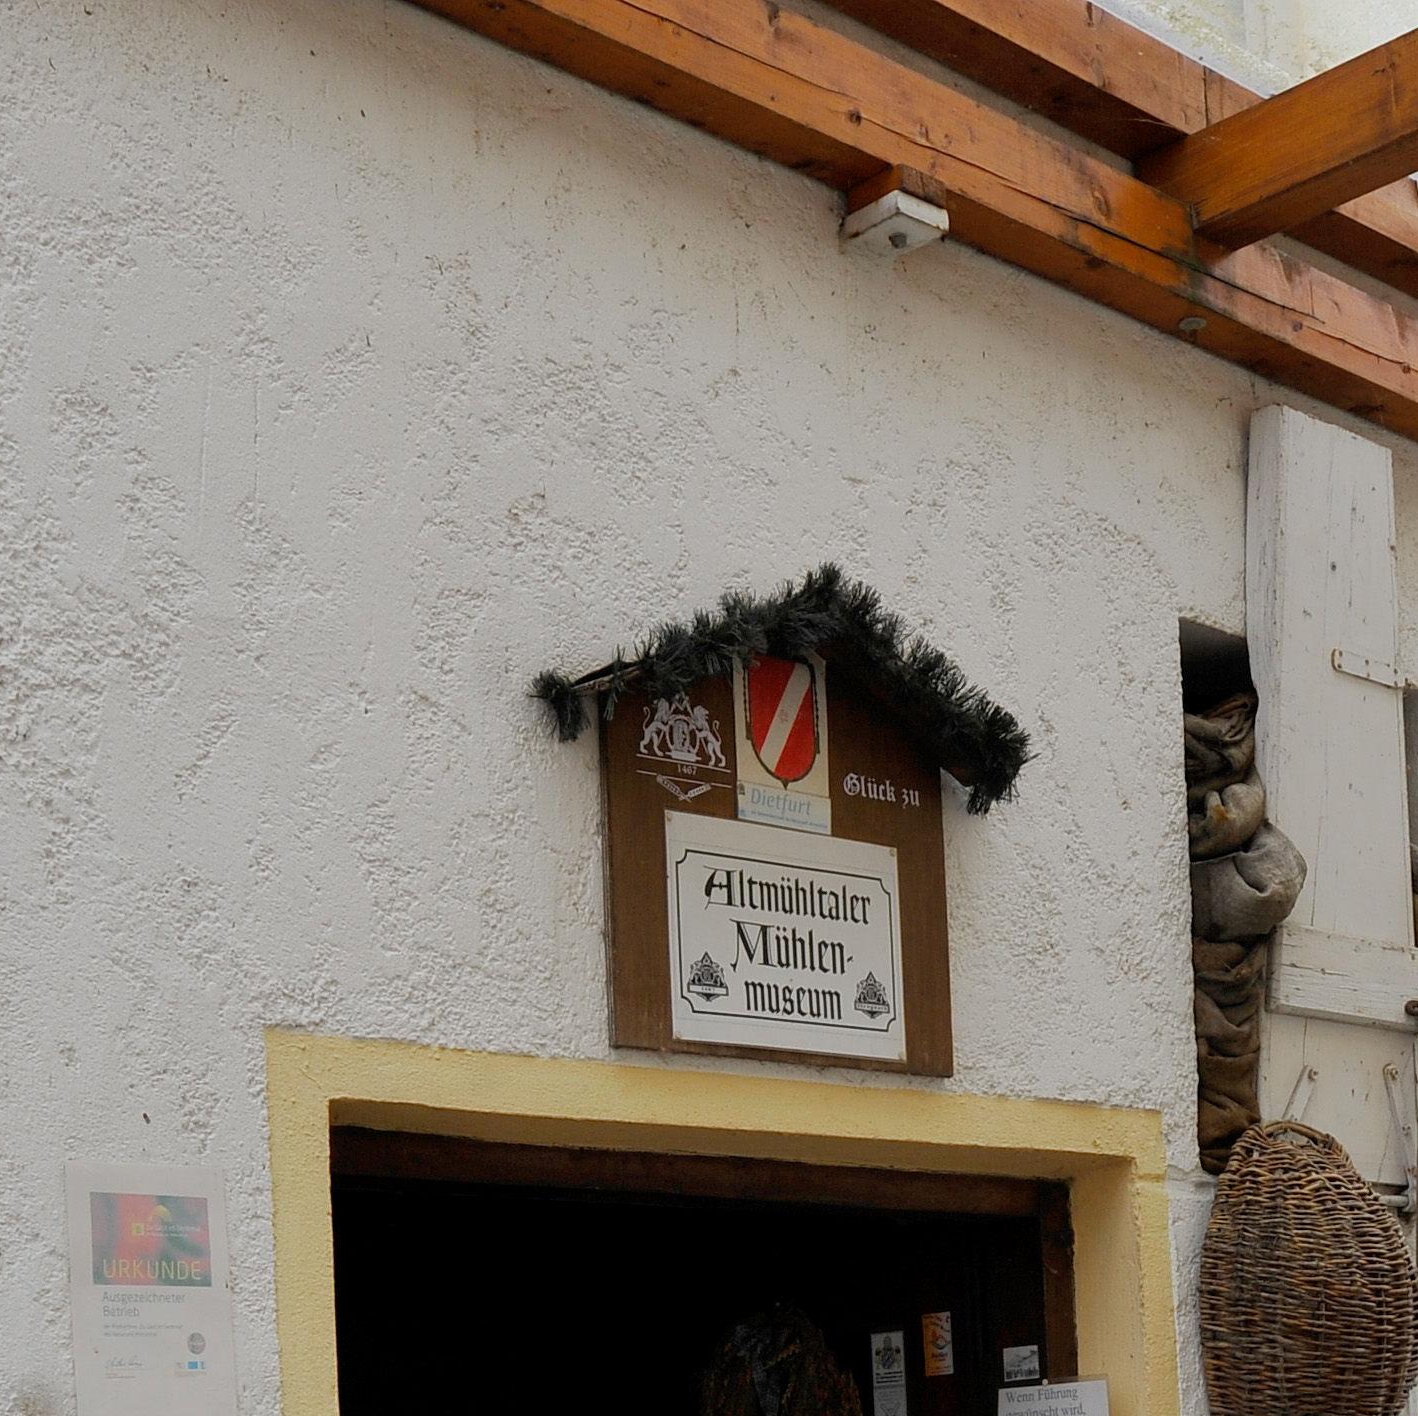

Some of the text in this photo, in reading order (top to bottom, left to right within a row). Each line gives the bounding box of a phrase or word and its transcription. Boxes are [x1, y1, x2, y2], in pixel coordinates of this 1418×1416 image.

[750, 787, 812, 816] Dietfurt
[843, 772, 921, 810] Glück zu
[703, 864, 871, 925] Altmühltaler
[729, 918, 854, 975] Mühlen-
[744, 979, 842, 1021] museum
[102, 1258, 202, 1281] URKUNDE
[101, 1291, 186, 1304] Ausgezeichneter
[102, 1305, 140, 1318] Betrieb
[1005, 1387, 1078, 1403] Wenn Führung
